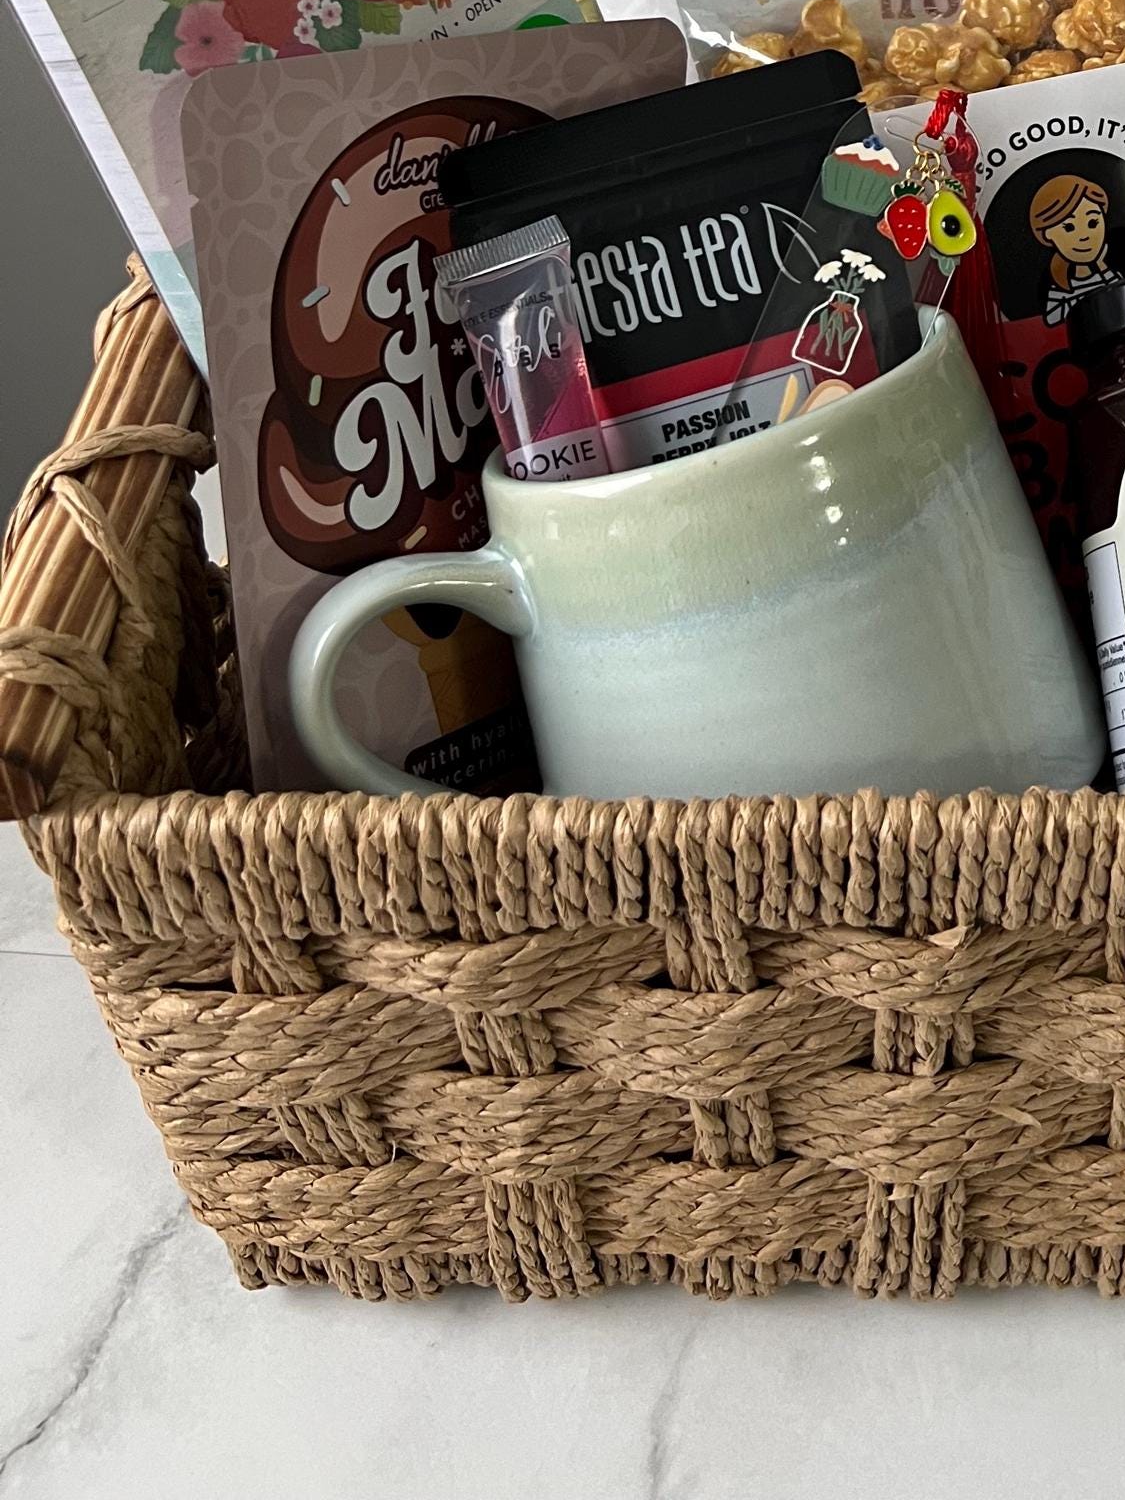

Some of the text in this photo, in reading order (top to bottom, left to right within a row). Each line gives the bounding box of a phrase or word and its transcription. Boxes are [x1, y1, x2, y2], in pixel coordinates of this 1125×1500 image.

[1008, 115, 1091, 151] GOOD,
[679, 212, 763, 308] tea
[661, 399, 751, 444] PASSION
[513, 439, 597, 481] OOKIE
